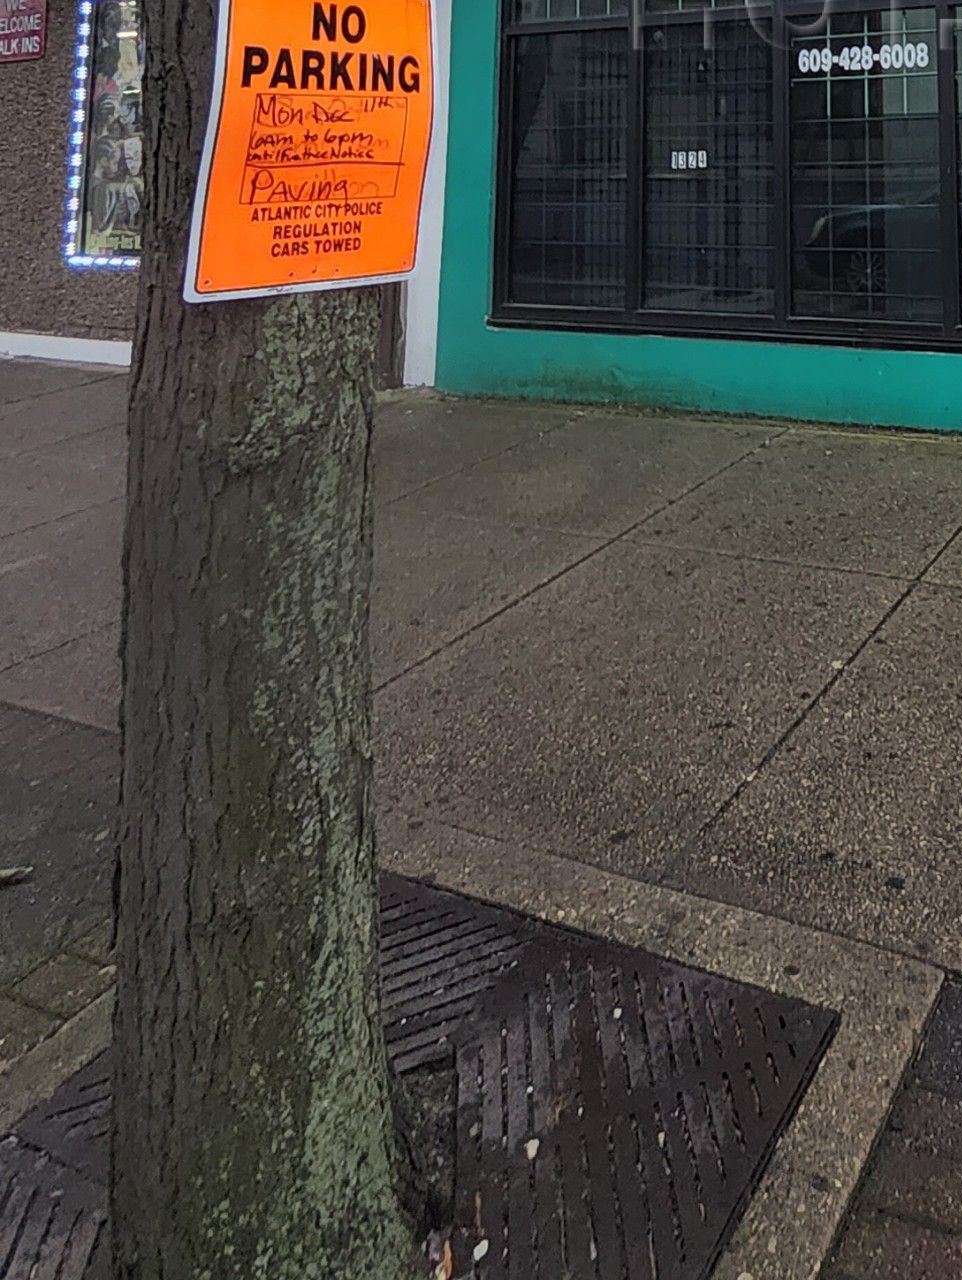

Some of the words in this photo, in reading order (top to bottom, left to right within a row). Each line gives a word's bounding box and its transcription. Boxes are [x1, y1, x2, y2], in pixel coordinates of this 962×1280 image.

[312, 2, 366, 43] NO
[798, 43, 929, 72] 609-428-6008
[241, 46, 420, 93] PARKING
[671, 150, 707, 169] 1324
[251, 205, 311, 222] ATLANTIC
[315, 203, 341, 219] CITY
[345, 201, 383, 217] POLICE
[272, 221, 362, 240] REGULATION
[271, 240, 309, 258] CARS
[315, 237, 361, 254] TOWED
